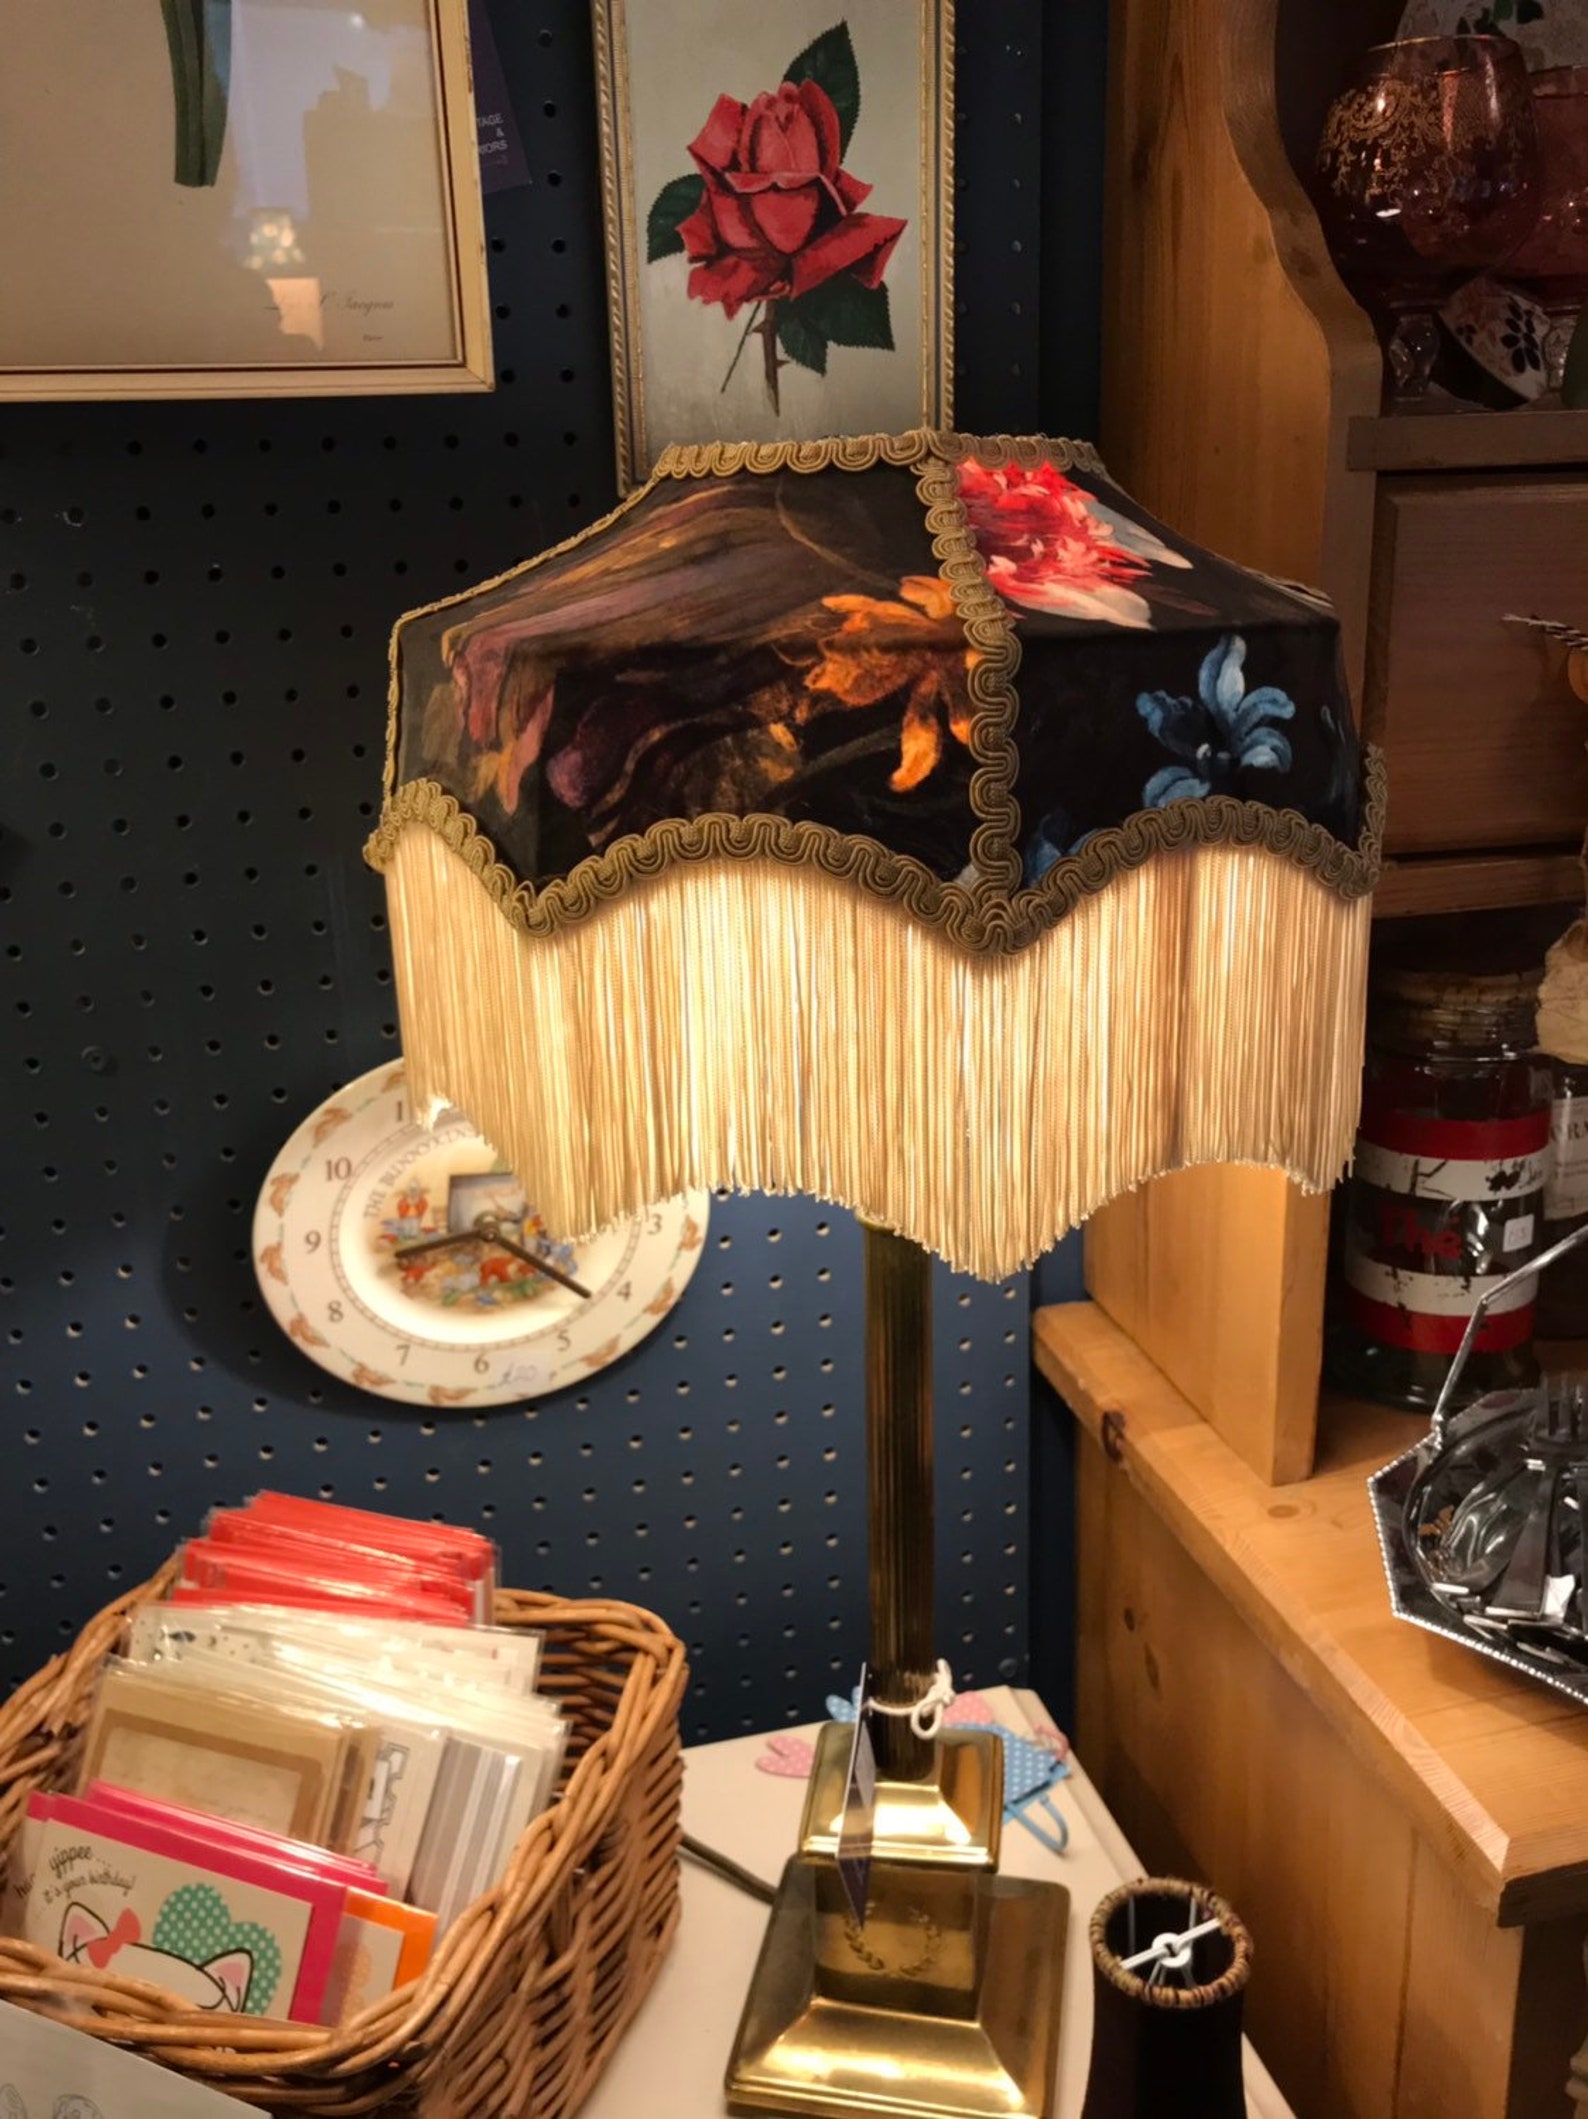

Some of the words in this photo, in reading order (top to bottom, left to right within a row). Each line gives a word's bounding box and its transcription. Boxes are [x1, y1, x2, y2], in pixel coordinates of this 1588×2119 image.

[326, 1157, 352, 1182] 10
[363, 1189, 386, 1219] THE
[646, 1216, 663, 1236] 3
[304, 1231, 322, 1254] 9
[616, 1281, 633, 1302] 4
[327, 1300, 344, 1323] 8
[556, 1331, 572, 1353] 5
[396, 1344, 412, 1367] 7
[473, 1351, 491, 1375] 6
